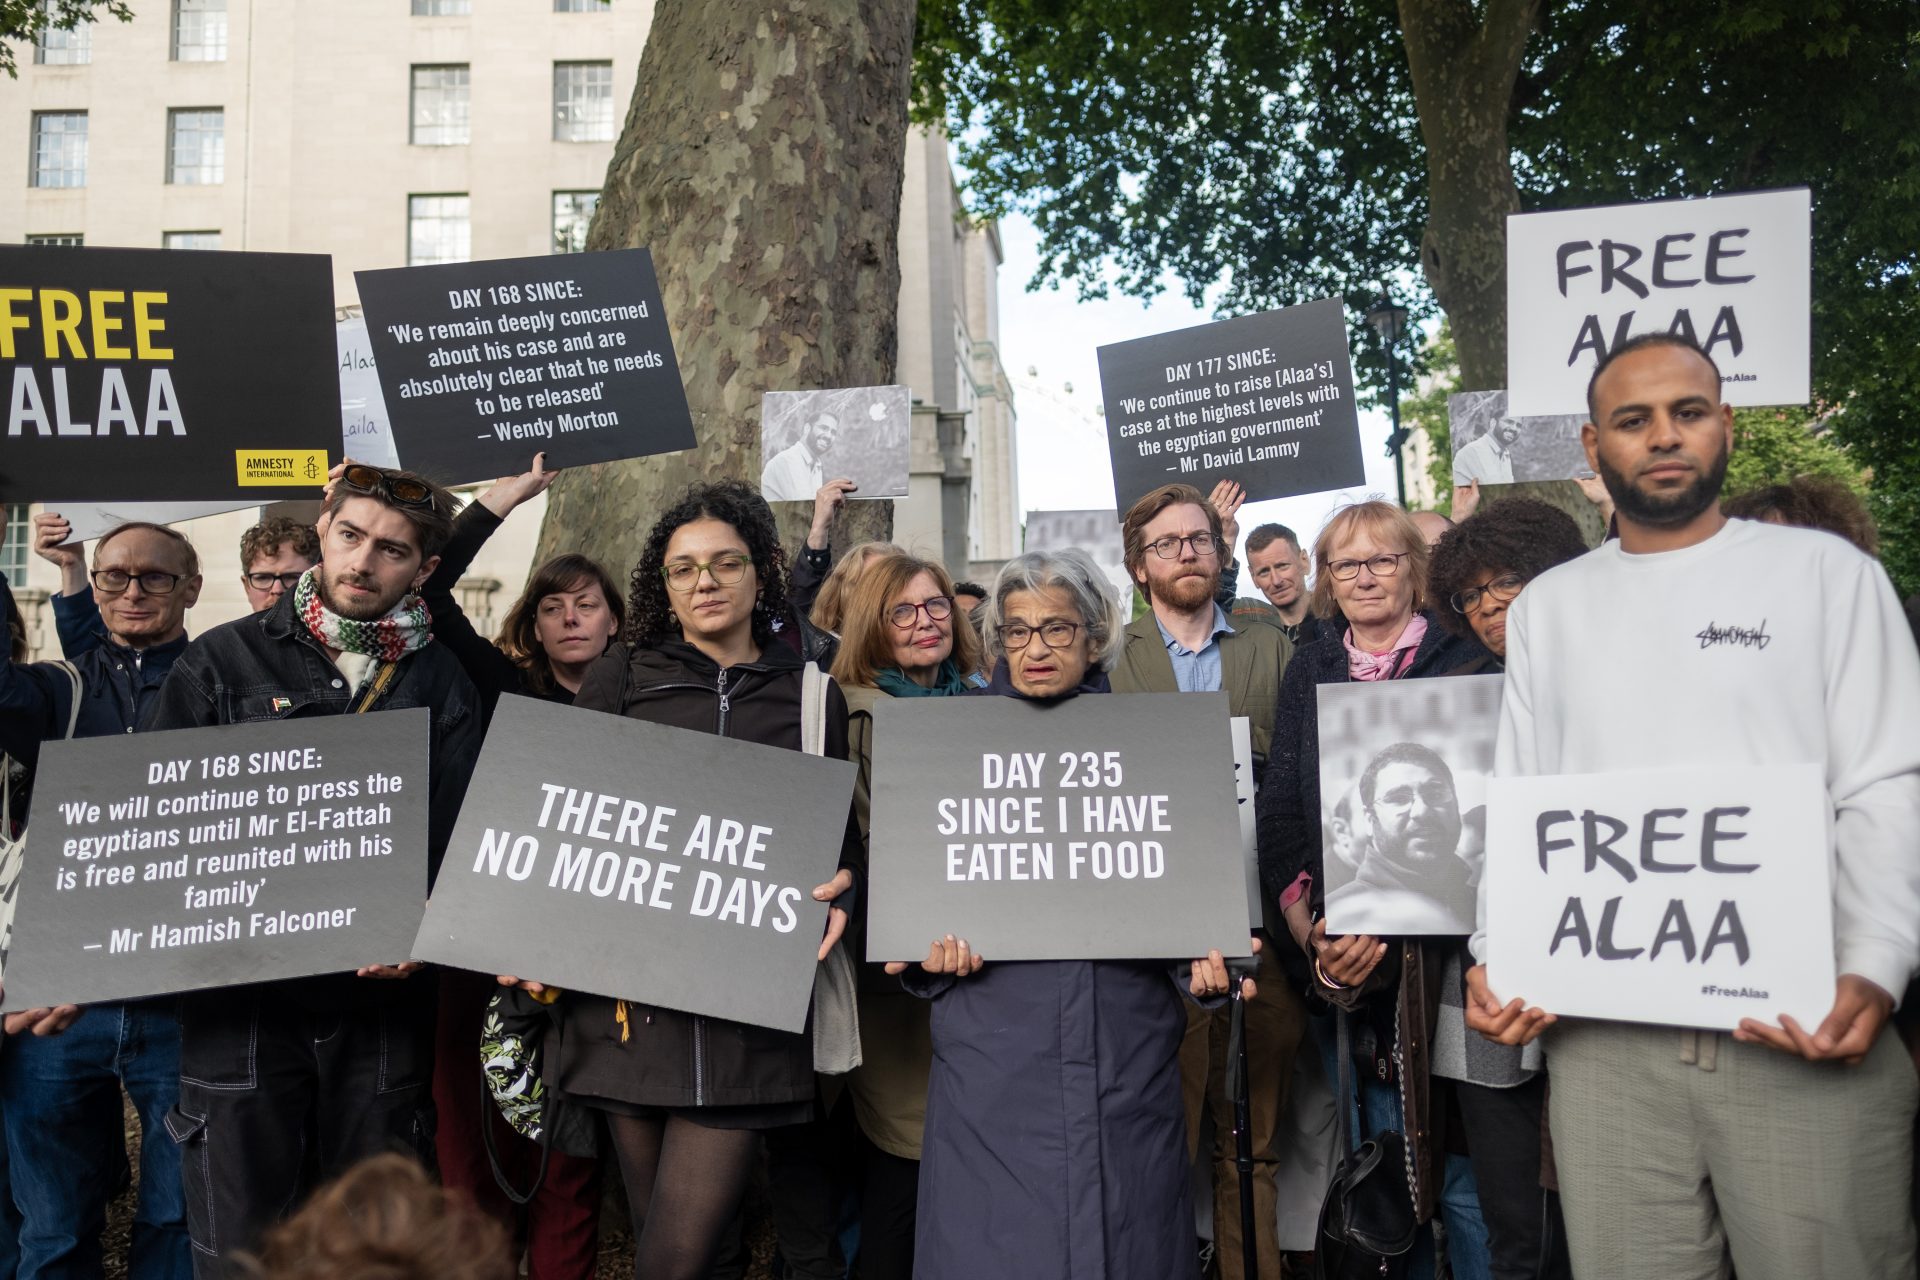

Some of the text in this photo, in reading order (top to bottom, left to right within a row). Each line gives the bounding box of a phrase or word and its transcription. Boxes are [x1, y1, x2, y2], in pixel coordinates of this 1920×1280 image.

[1556, 228, 1756, 299] FREE
[448, 279, 583, 310] DAY 168 SINCE:
[0, 288, 174, 360] FREE
[428, 316, 494, 341] remain
[497, 310, 555, 334] deeply
[559, 300, 649, 327] concerned
[428, 331, 627, 368] about his case and are
[1165, 347, 1277, 383] DAY 177 SINCE:
[399, 350, 663, 399] absolutely clear that he needs
[1149, 387, 1212, 410] continue
[1214, 382, 1230, 398] to
[1234, 375, 1272, 394] raise
[1720, 373, 1757, 383] eeAlaa
[8, 367, 187, 435] ALAA
[475, 398, 495, 416] to
[498, 394, 522, 413] be
[1119, 383, 1340, 438] case at the highest levels with
[493, 417, 553, 442] Wendy
[557, 411, 619, 433] Morton
[1137, 439, 1161, 457] the
[1165, 429, 1227, 454] egyptian
[246, 458, 294, 469] AMNESTY
[246, 470, 295, 478] INTERNATIONAL
[1180, 455, 1199, 473] Mr
[1202, 447, 1244, 469] David
[1247, 441, 1300, 462] Lammy
[148, 747, 322, 785] DAY 168 SINCE:
[983, 751, 1123, 789] DAY 235
[109, 795, 150, 821] will
[157, 789, 259, 816] continue
[266, 784, 289, 805] to
[297, 780, 359, 807] press
[366, 772, 403, 795] the
[937, 795, 1172, 836] SINCE I HAVE
[63, 802, 391, 861] egyptians until Mr El-Fattah
[537, 782, 773, 871] THERE ARE
[1536, 806, 1761, 884] FREE
[56, 833, 393, 891] is free and reunited with his
[472, 827, 802, 933] NO MORE DAYS
[946, 840, 1165, 882] EATEN FOOD
[109, 928, 143, 954] Mr
[150, 916, 241, 949] Hamish
[249, 907, 357, 937] Falconer
[1549, 895, 1751, 966] ALAA
[1701, 985, 1769, 999] #FreeAlaa
